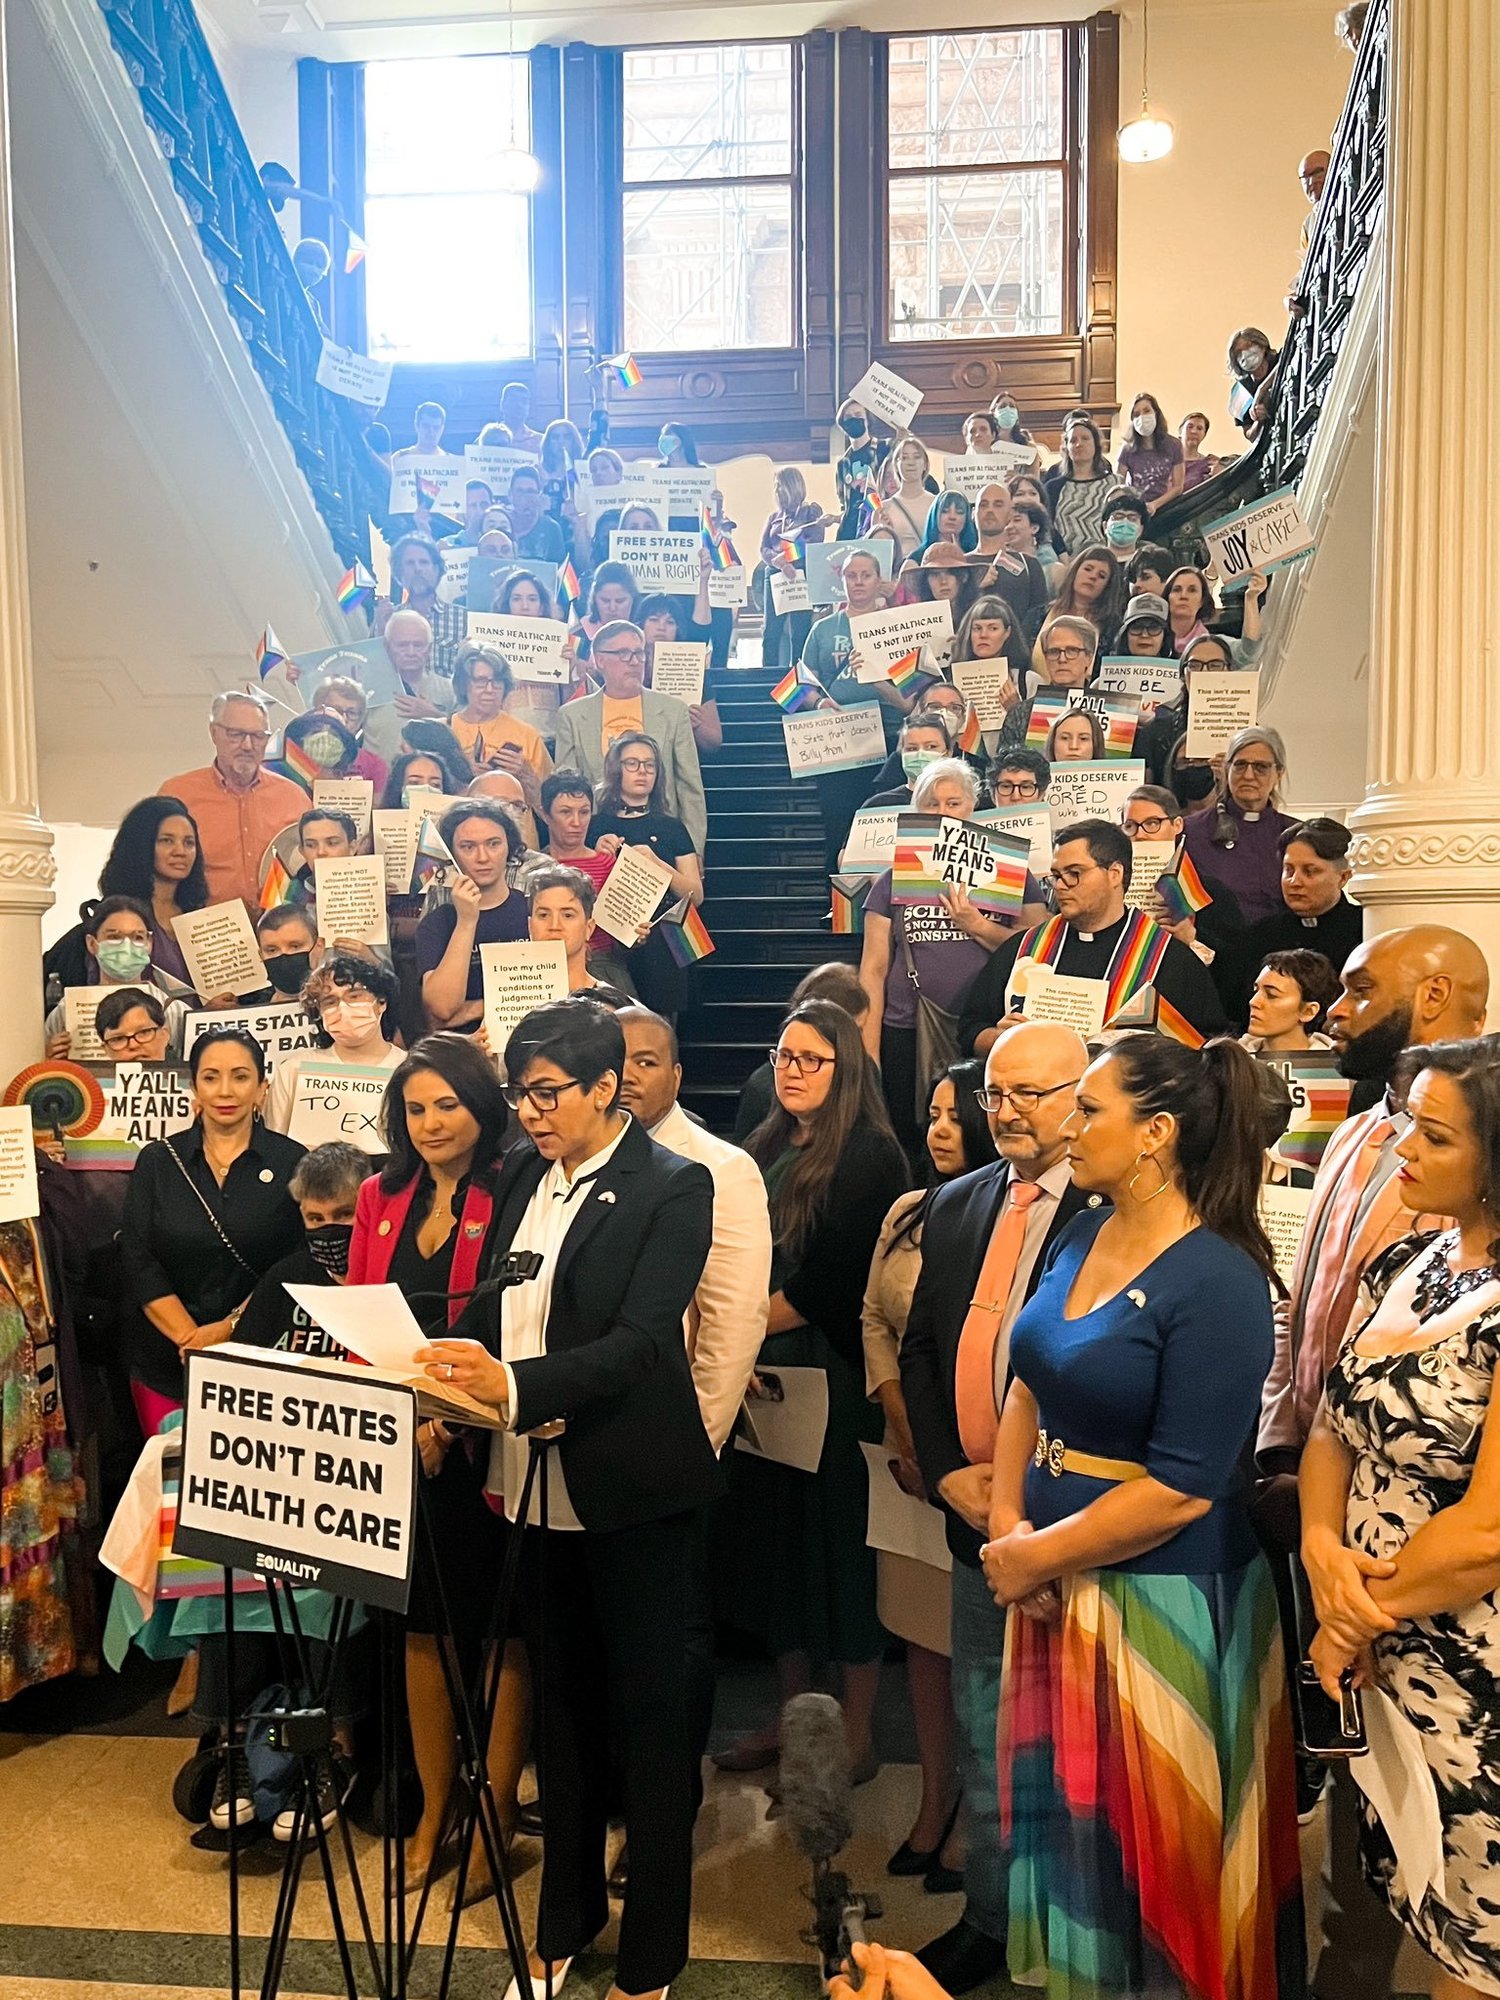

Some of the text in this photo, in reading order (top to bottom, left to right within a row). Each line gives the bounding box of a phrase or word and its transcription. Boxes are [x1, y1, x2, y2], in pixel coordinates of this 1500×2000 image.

[1208, 502, 1285, 543] TRANS KIDS DESERVE
[617, 537, 694, 547] FREE STATES
[621, 552, 688, 562] DON'T BAN
[1222, 528, 1253, 575] JOY
[628, 564, 700, 581] UMAN RIGHTS
[475, 626, 561, 642] TRANS HEALTHCARE
[858, 615, 944, 640] TRANS HEALTHCARE
[499, 642, 516, 650] NOT
[518, 644, 530, 652] UP
[873, 630, 933, 650] IS NOT UP FOR
[1104, 667, 1179, 680] TRANS KIDS DESE
[1103, 679, 1165, 694] TO BE
[788, 711, 869, 731] TRANS KIDS DESERVE
[1054, 772, 1128, 783] KIDS DESERVE
[1050, 783, 1087, 793] to be
[857, 817, 885, 826] TRANS
[1058, 806, 1111, 821] who they
[942, 825, 990, 855] Y'ALL
[932, 843, 995, 873] MEANS
[941, 864, 979, 888] ALL
[912, 920, 937, 930] NOT
[939, 920, 948, 930] A
[501, 994, 546, 1003] judgment.
[255, 1012, 311, 1031] STAT
[119, 1072, 183, 1094] Y'ALL
[305, 1078, 384, 1094] TRANS KIDS
[111, 1096, 190, 1118] MEANS
[299, 1095, 340, 1111] TO
[1278, 1211, 1306, 1220] father
[200, 1381, 398, 1446] FREE STATES
[210, 1430, 383, 1495] DON'T BAN
[188, 1475, 402, 1551] HEALTH CARE
[256, 1552, 322, 1582] EQUALITY
